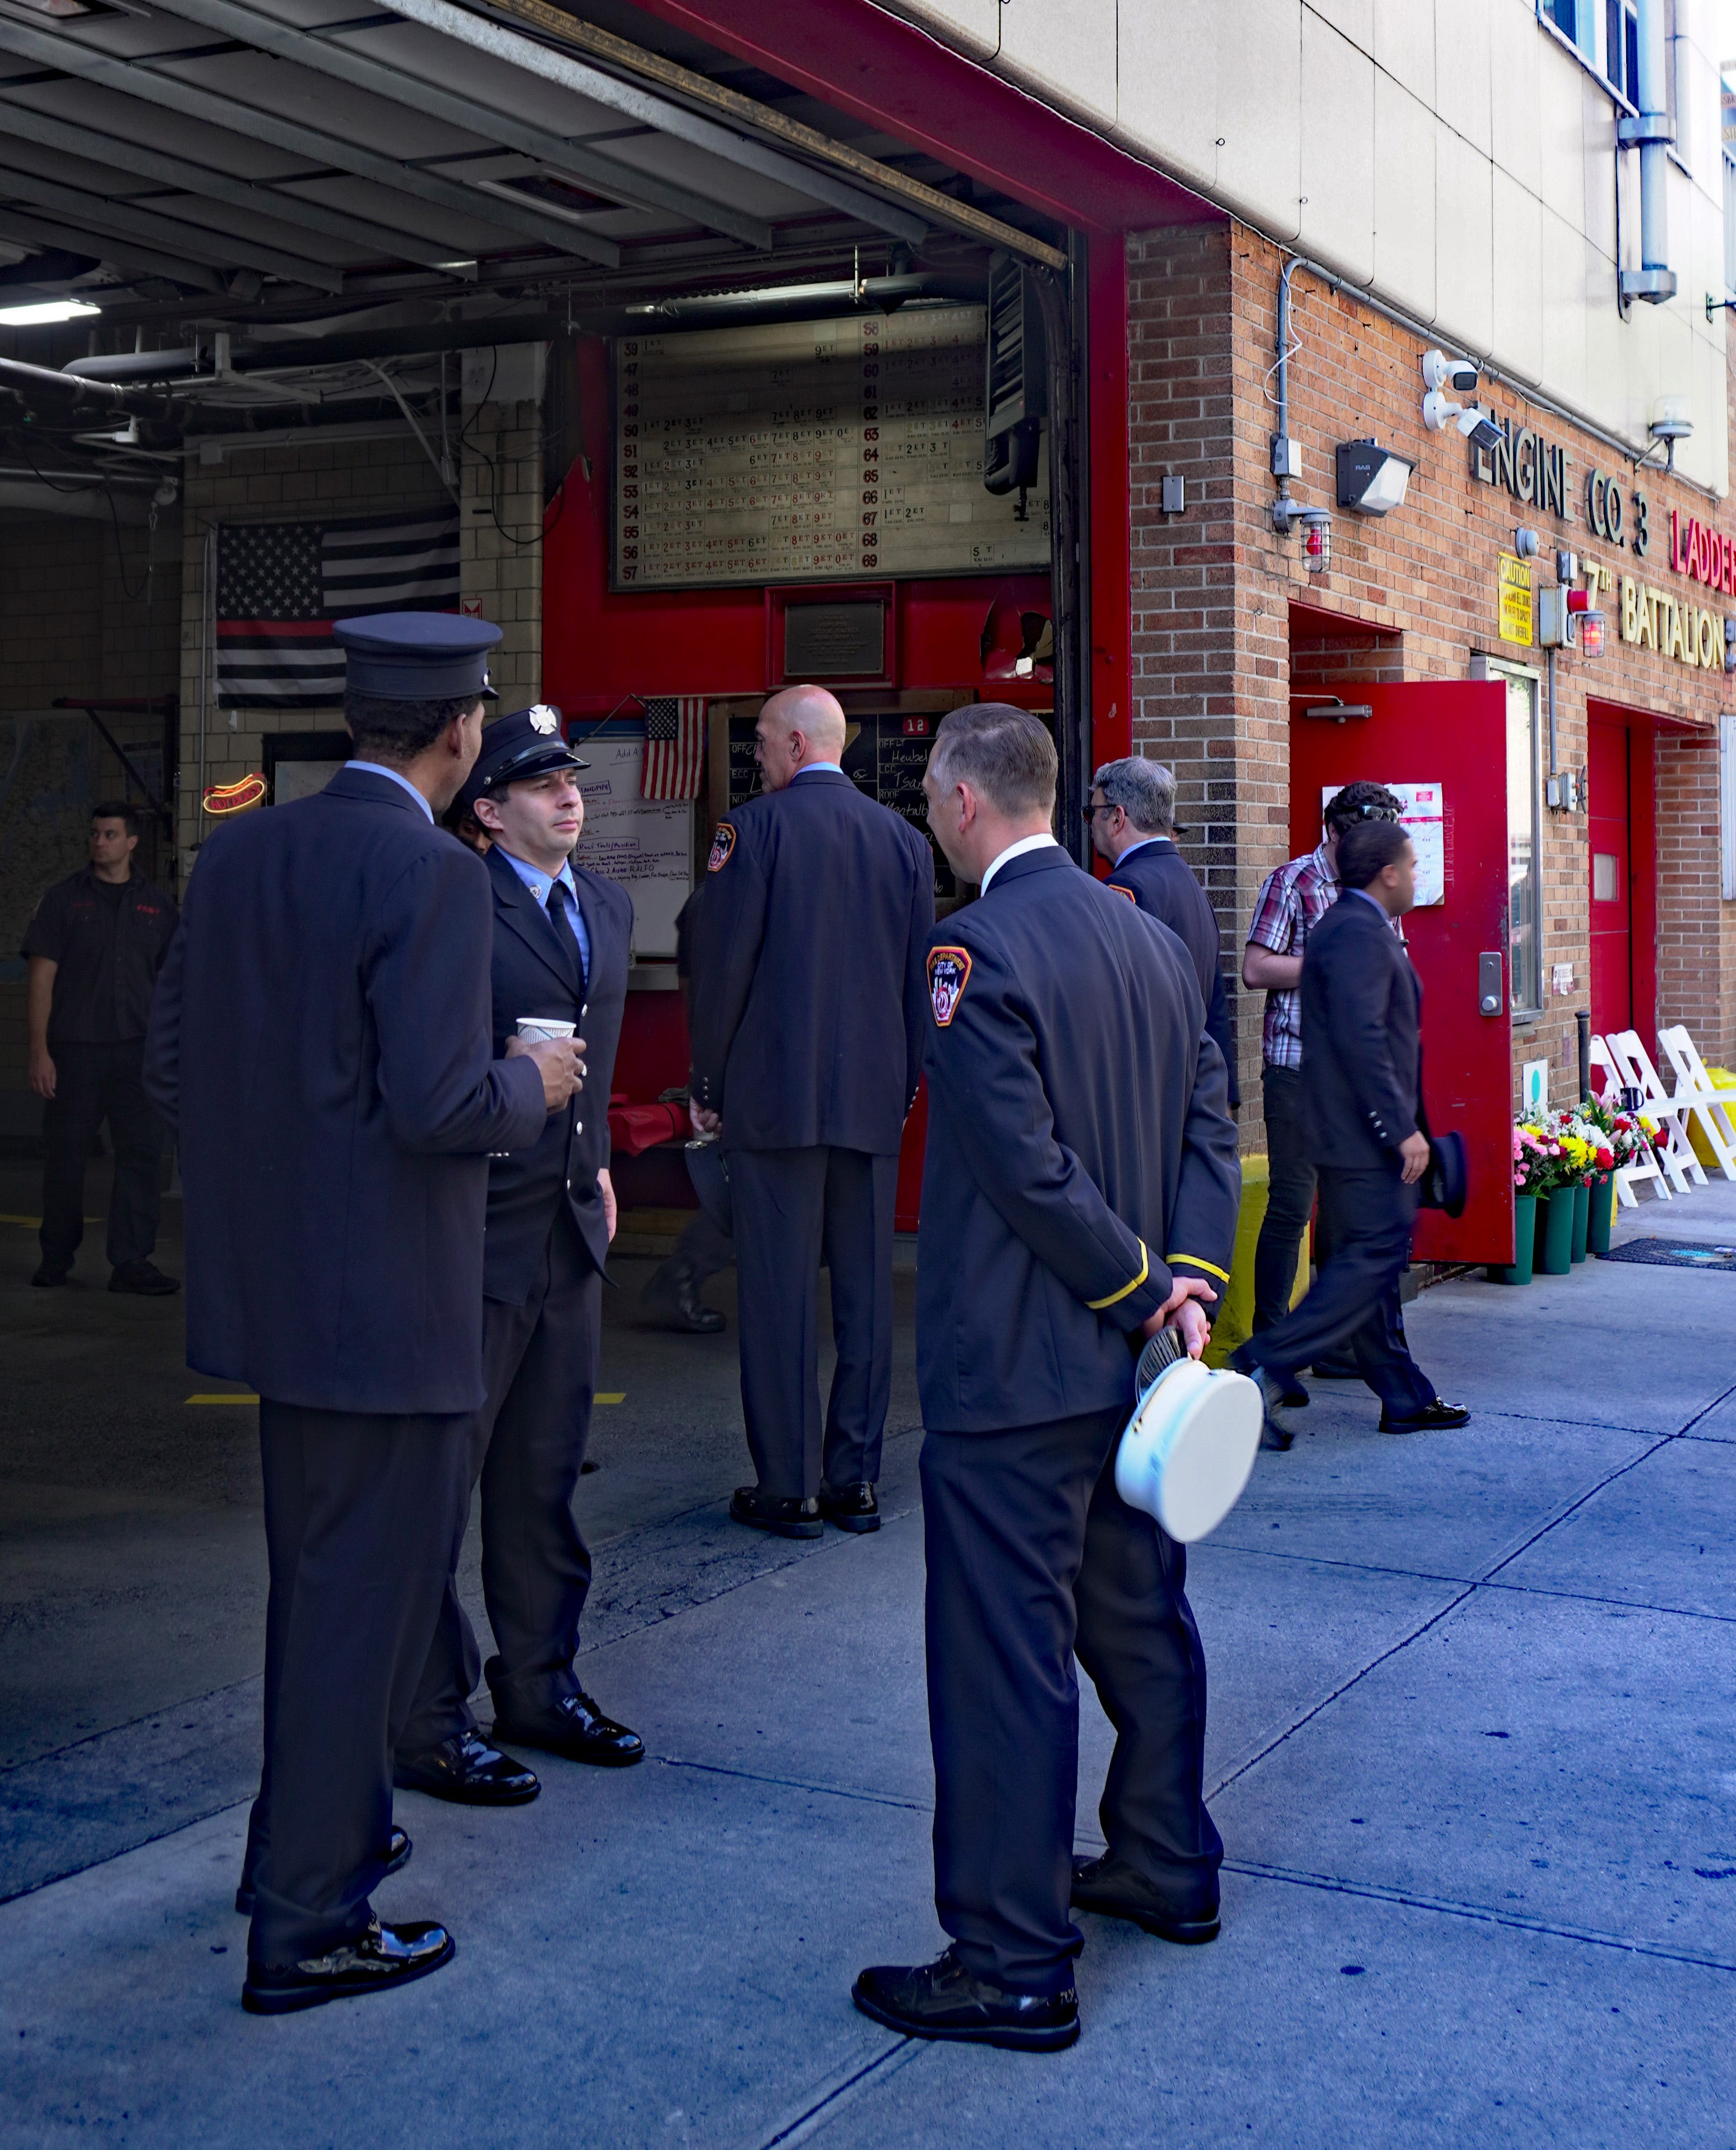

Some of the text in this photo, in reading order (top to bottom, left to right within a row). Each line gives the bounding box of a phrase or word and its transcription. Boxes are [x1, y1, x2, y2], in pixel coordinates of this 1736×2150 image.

[863, 322, 879, 336] 58
[623, 342, 638, 356] 39
[863, 342, 879, 356] 59
[623, 363, 638, 377] 47
[863, 363, 879, 378] 60
[623, 383, 639, 397] 48
[863, 385, 877, 400] 61
[863, 405, 878, 421] 62
[623, 424, 638, 437] 50
[864, 427, 879, 442] 63
[624, 444, 637, 458] 51
[863, 447, 879, 462] 64
[623, 465, 638, 479] 52
[863, 469, 879, 484] 65
[1472, 401, 1650, 557] ENGINE CO. 3
[623, 484, 638, 498] 53
[862, 490, 878, 505] 66
[623, 505, 638, 519] 54
[862, 511, 878, 526] 67
[623, 525, 638, 539] 55
[862, 533, 878, 547] 68
[623, 546, 638, 559] 56
[862, 554, 878, 568] 69
[622, 565, 638, 581] 57
[1500, 558, 1530, 588] CAUTION
[1582, 559, 1725, 672] 7TH BATTALION
[1516, 624, 1529, 640] OVERFILL
[908, 719, 924, 731] 12
[732, 744, 746, 753] OFF
[879, 740, 894, 748] OFF
[615, 749, 631, 760] Add
[732, 770, 748, 779] ECC
[578, 784, 608, 793] TANDPIPE
[879, 790, 899, 799] ROOF
[937, 953, 965, 971] DEPARTMENT
